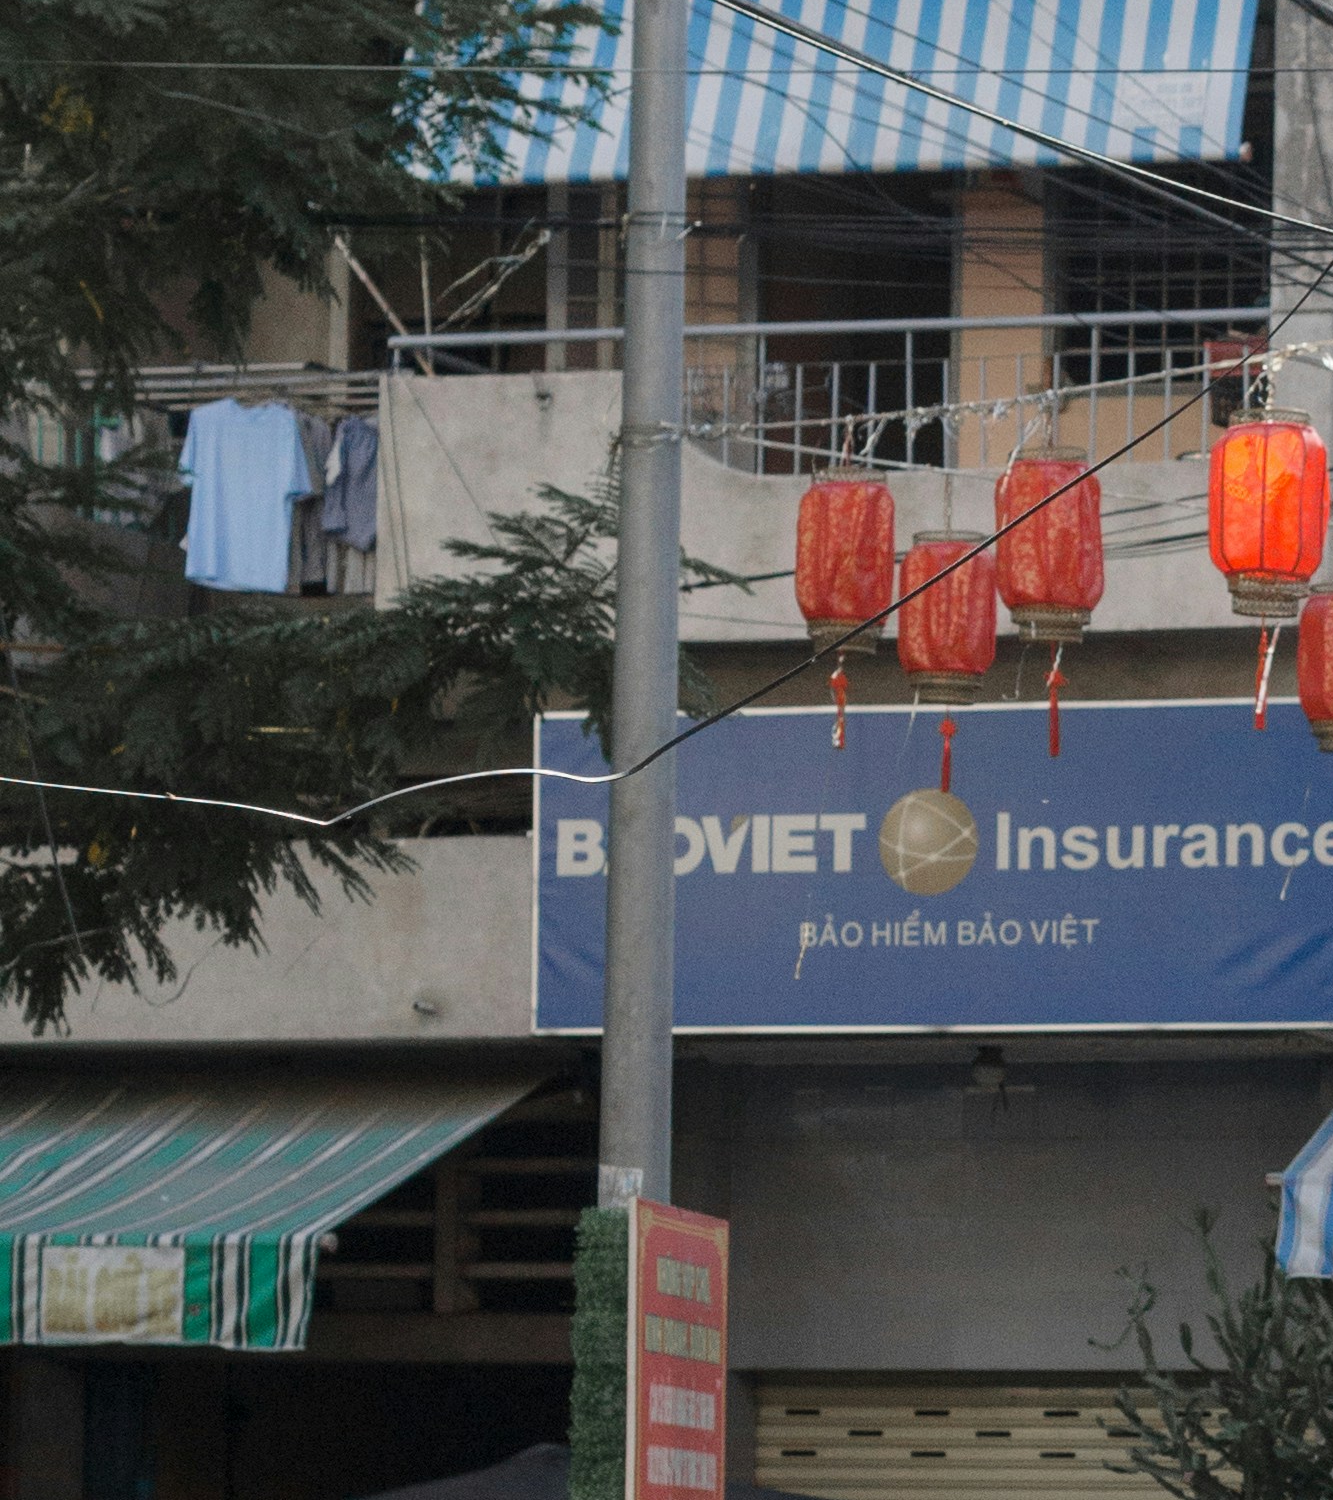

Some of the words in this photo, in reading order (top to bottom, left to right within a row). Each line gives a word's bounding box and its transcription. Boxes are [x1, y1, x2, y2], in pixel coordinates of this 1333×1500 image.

[556, 813, 867, 877] BOVIET
[801, 912, 863, 948] BẢO
[871, 909, 947, 946] HIỂM
[958, 912, 1023, 946] BẢO
[1029, 916, 1100, 950] VIỆT
